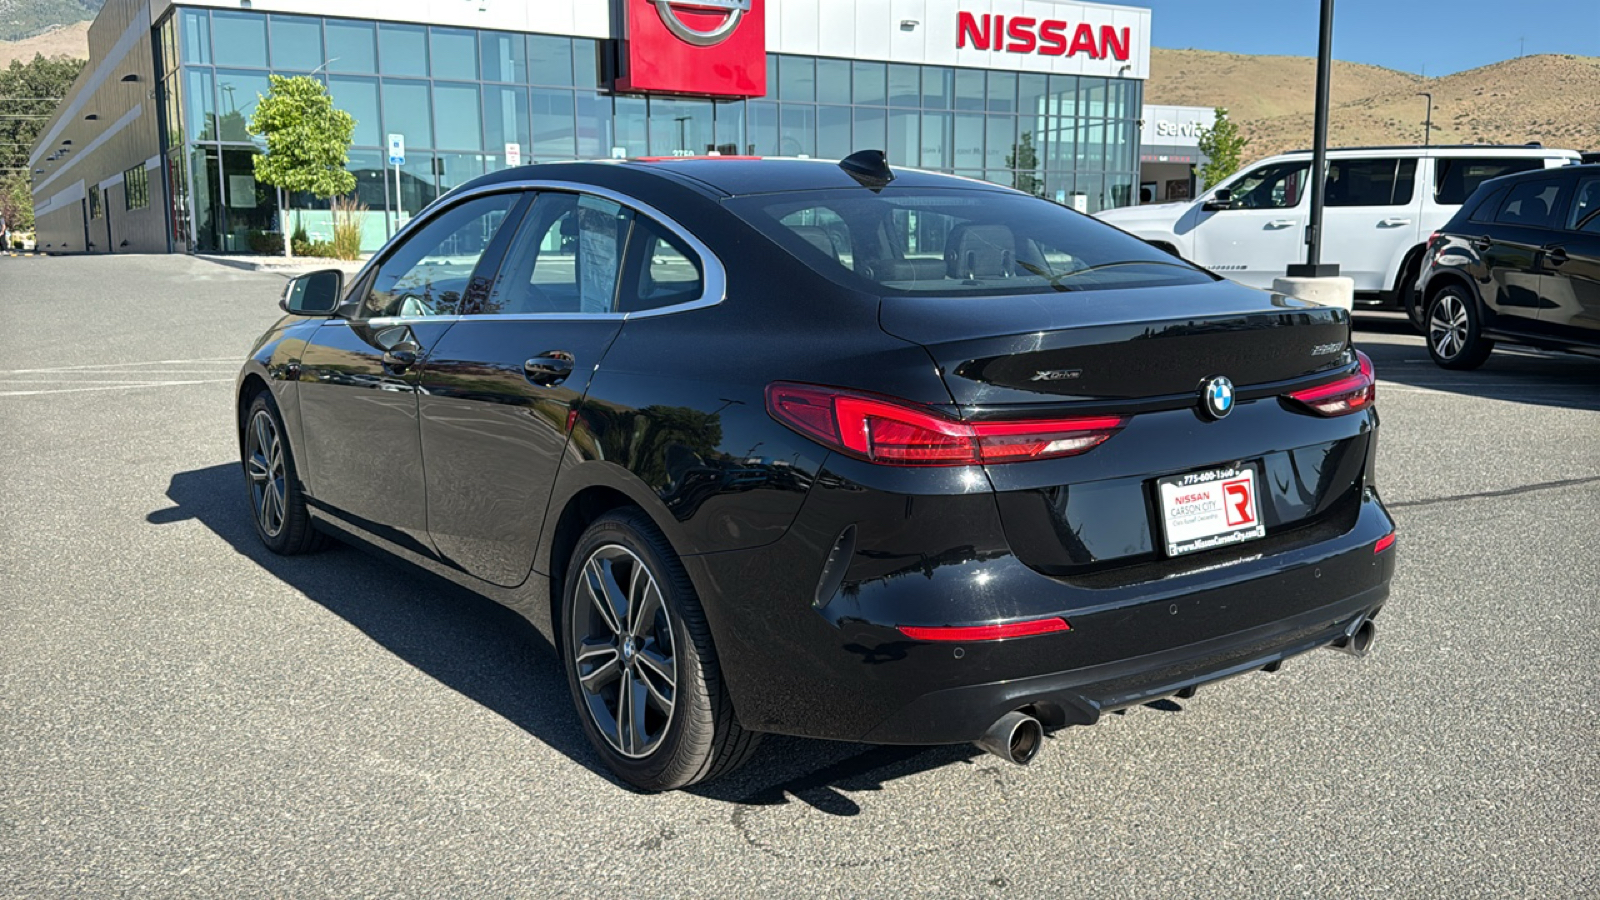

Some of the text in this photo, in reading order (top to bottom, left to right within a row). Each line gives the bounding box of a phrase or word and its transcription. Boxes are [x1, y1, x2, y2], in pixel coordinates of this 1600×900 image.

[956, 11, 1130, 61] NISSAN
[1156, 119, 1214, 138] Servic
[1175, 491, 1210, 505] NISSAN
[1170, 501, 1217, 517] CARSON CITY
